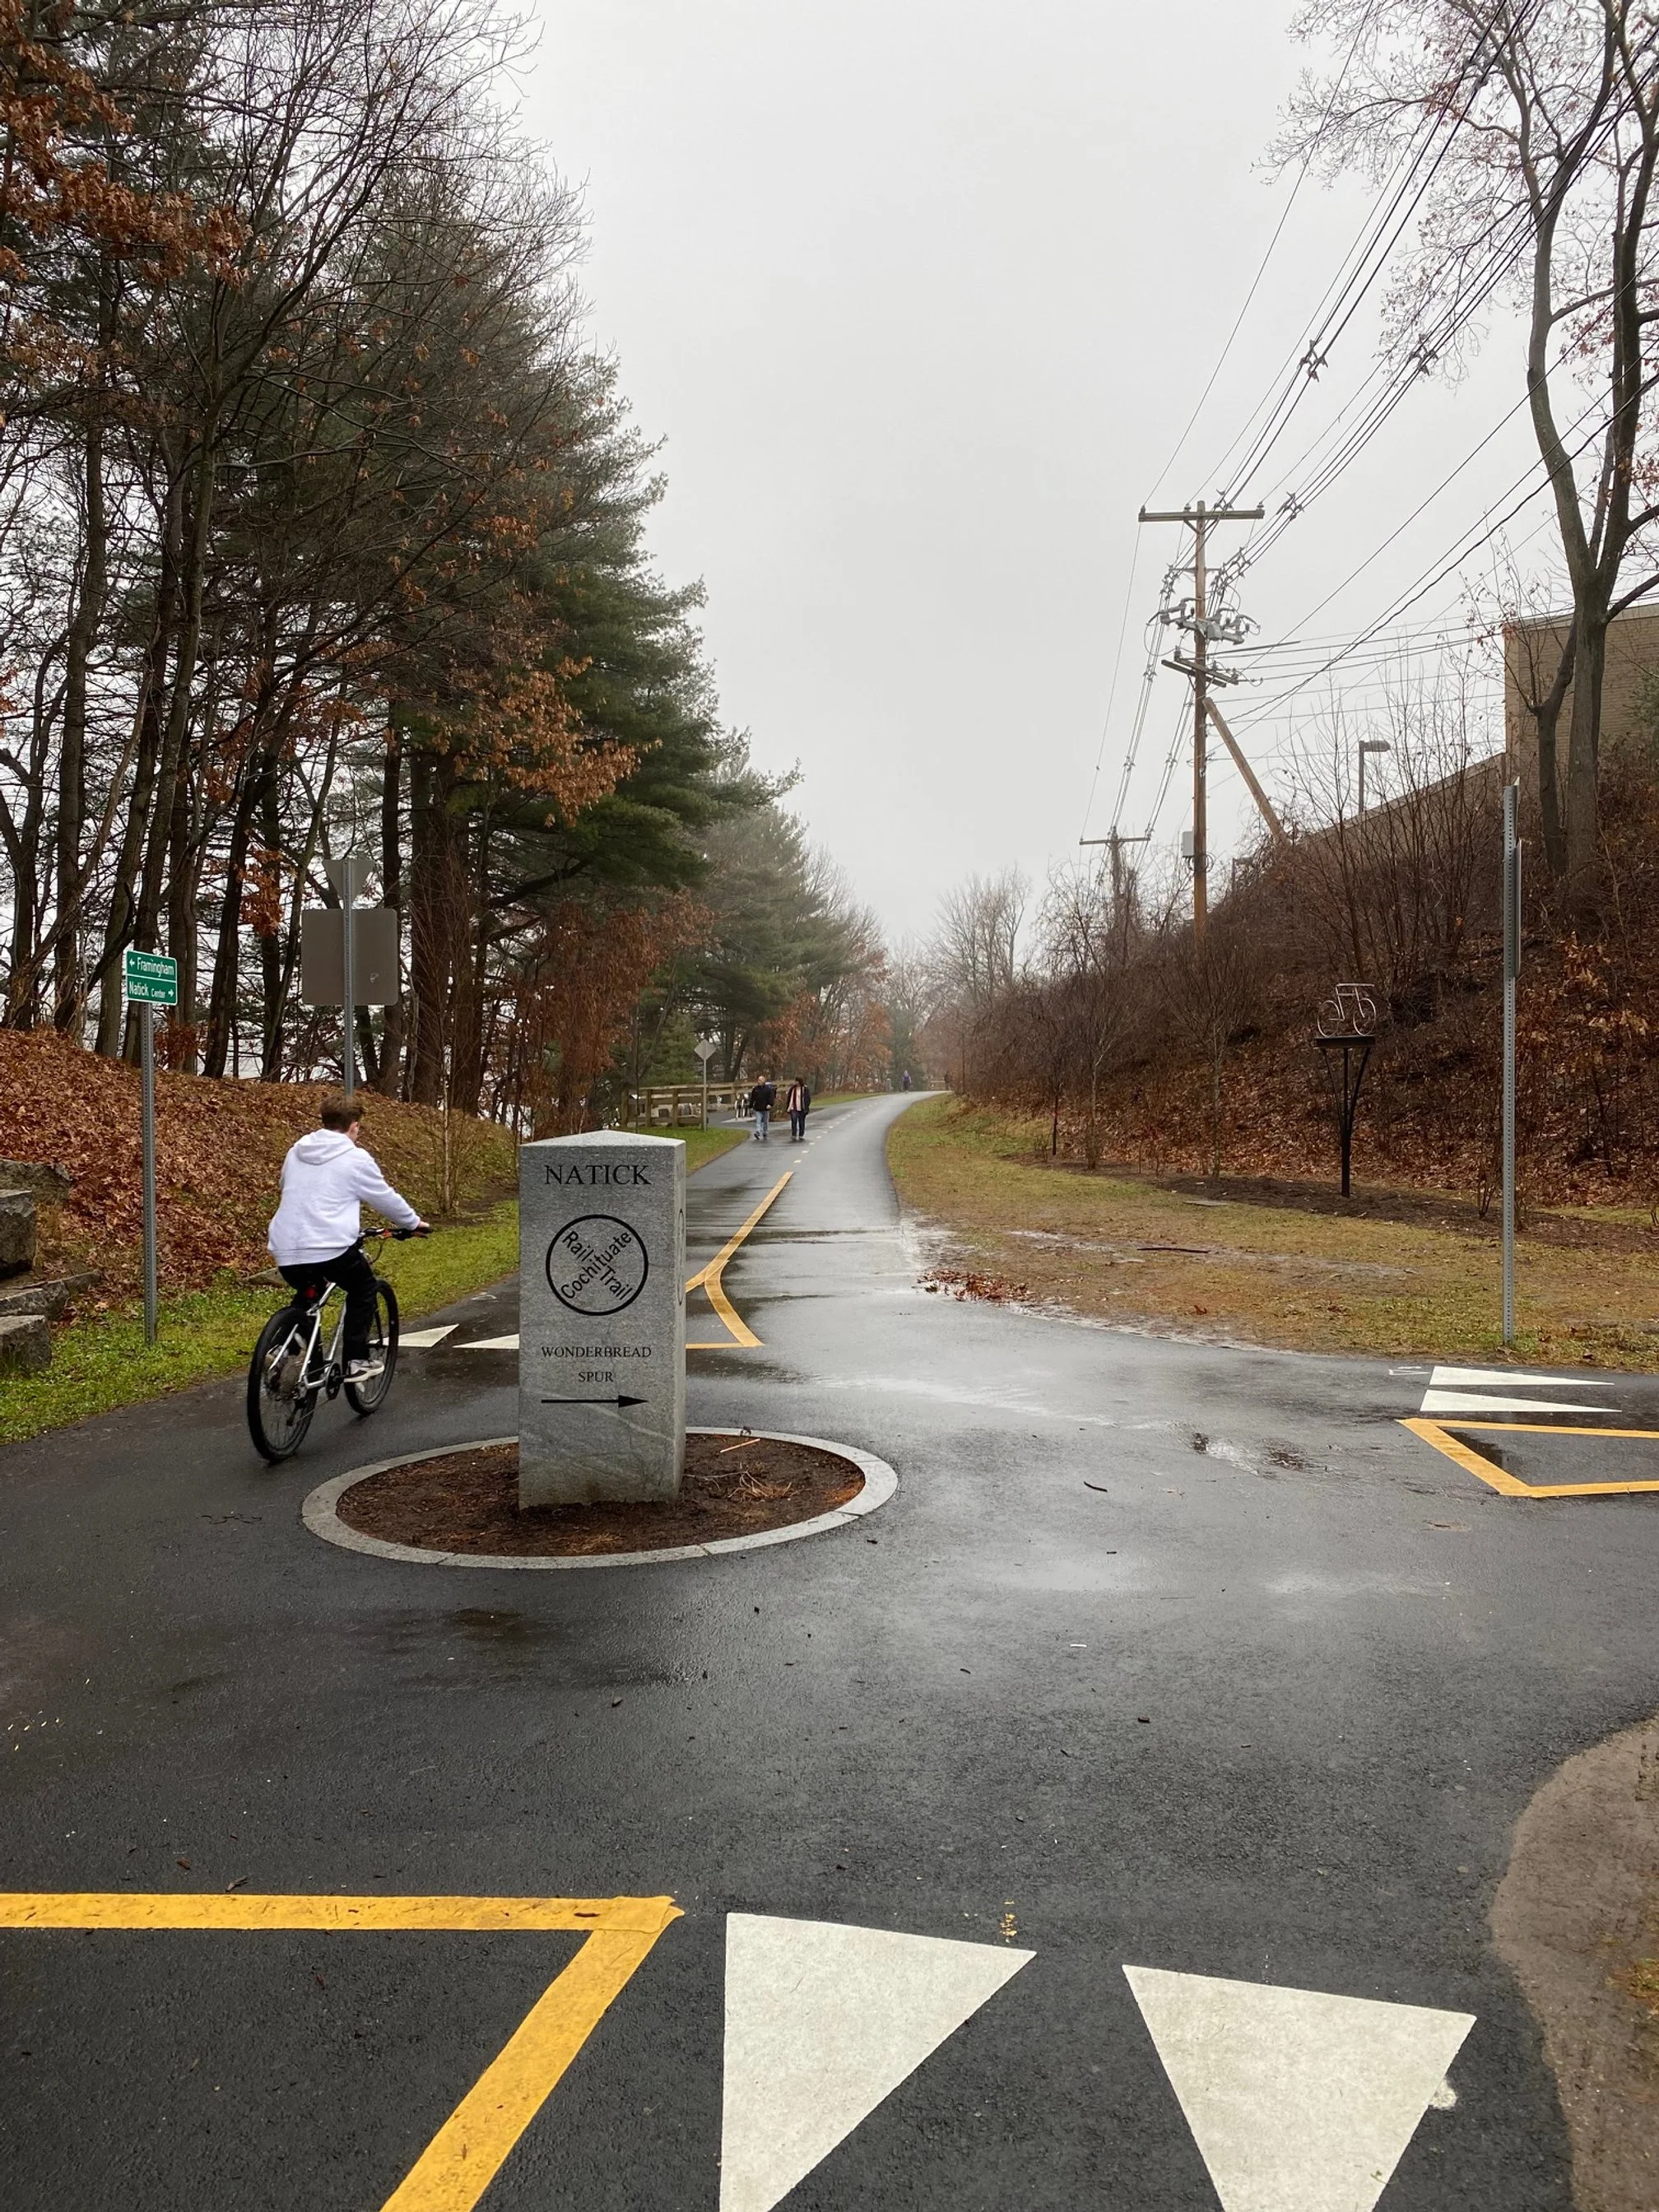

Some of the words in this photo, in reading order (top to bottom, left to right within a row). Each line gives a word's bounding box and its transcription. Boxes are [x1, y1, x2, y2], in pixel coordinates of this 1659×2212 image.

[137, 957, 174, 978] Framingham
[128, 981, 149, 997] Natick
[151, 988, 166, 998] Center
[544, 1164, 652, 1185] NATICK
[560, 1232, 632, 1299] Cochituate
[562, 1230, 595, 1262] Rail
[599, 1266, 633, 1300] Trail
[541, 1346, 652, 1358] WONDERBREAD
[578, 1371, 614, 1382] SPUR
